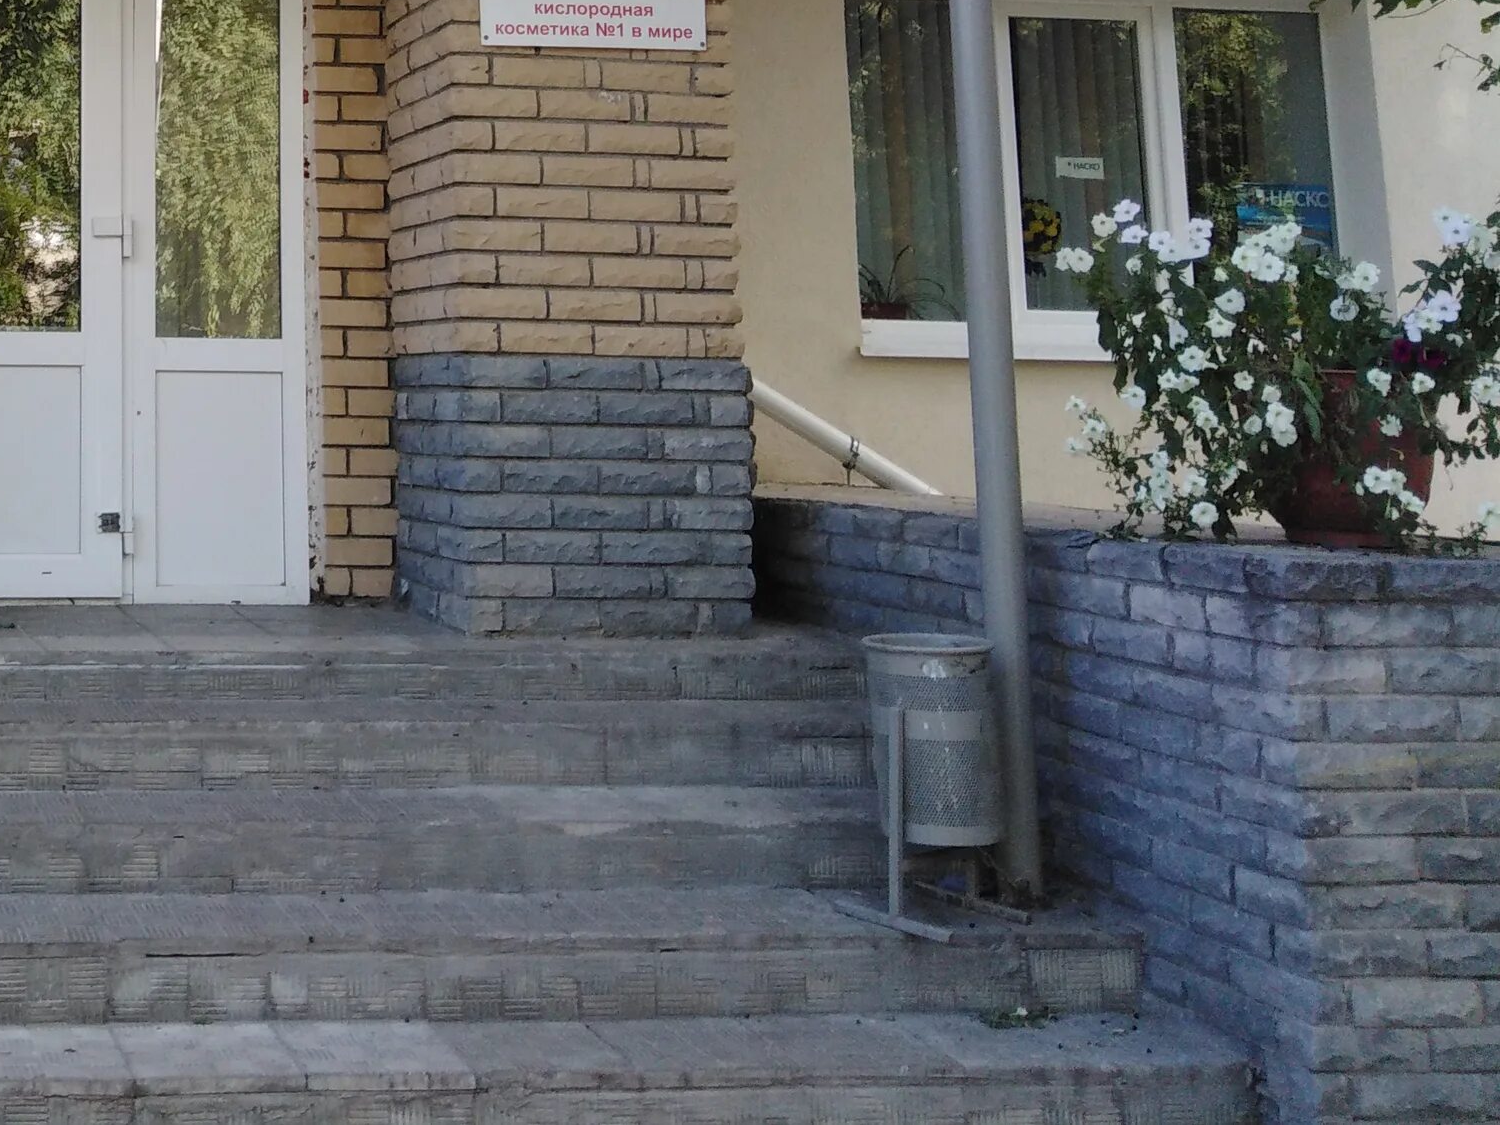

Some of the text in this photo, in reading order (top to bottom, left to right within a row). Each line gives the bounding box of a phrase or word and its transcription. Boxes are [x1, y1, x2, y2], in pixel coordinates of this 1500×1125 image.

[534, 1, 654, 19] кислородная
[495, 22, 693, 43] косметика №1 в мире
